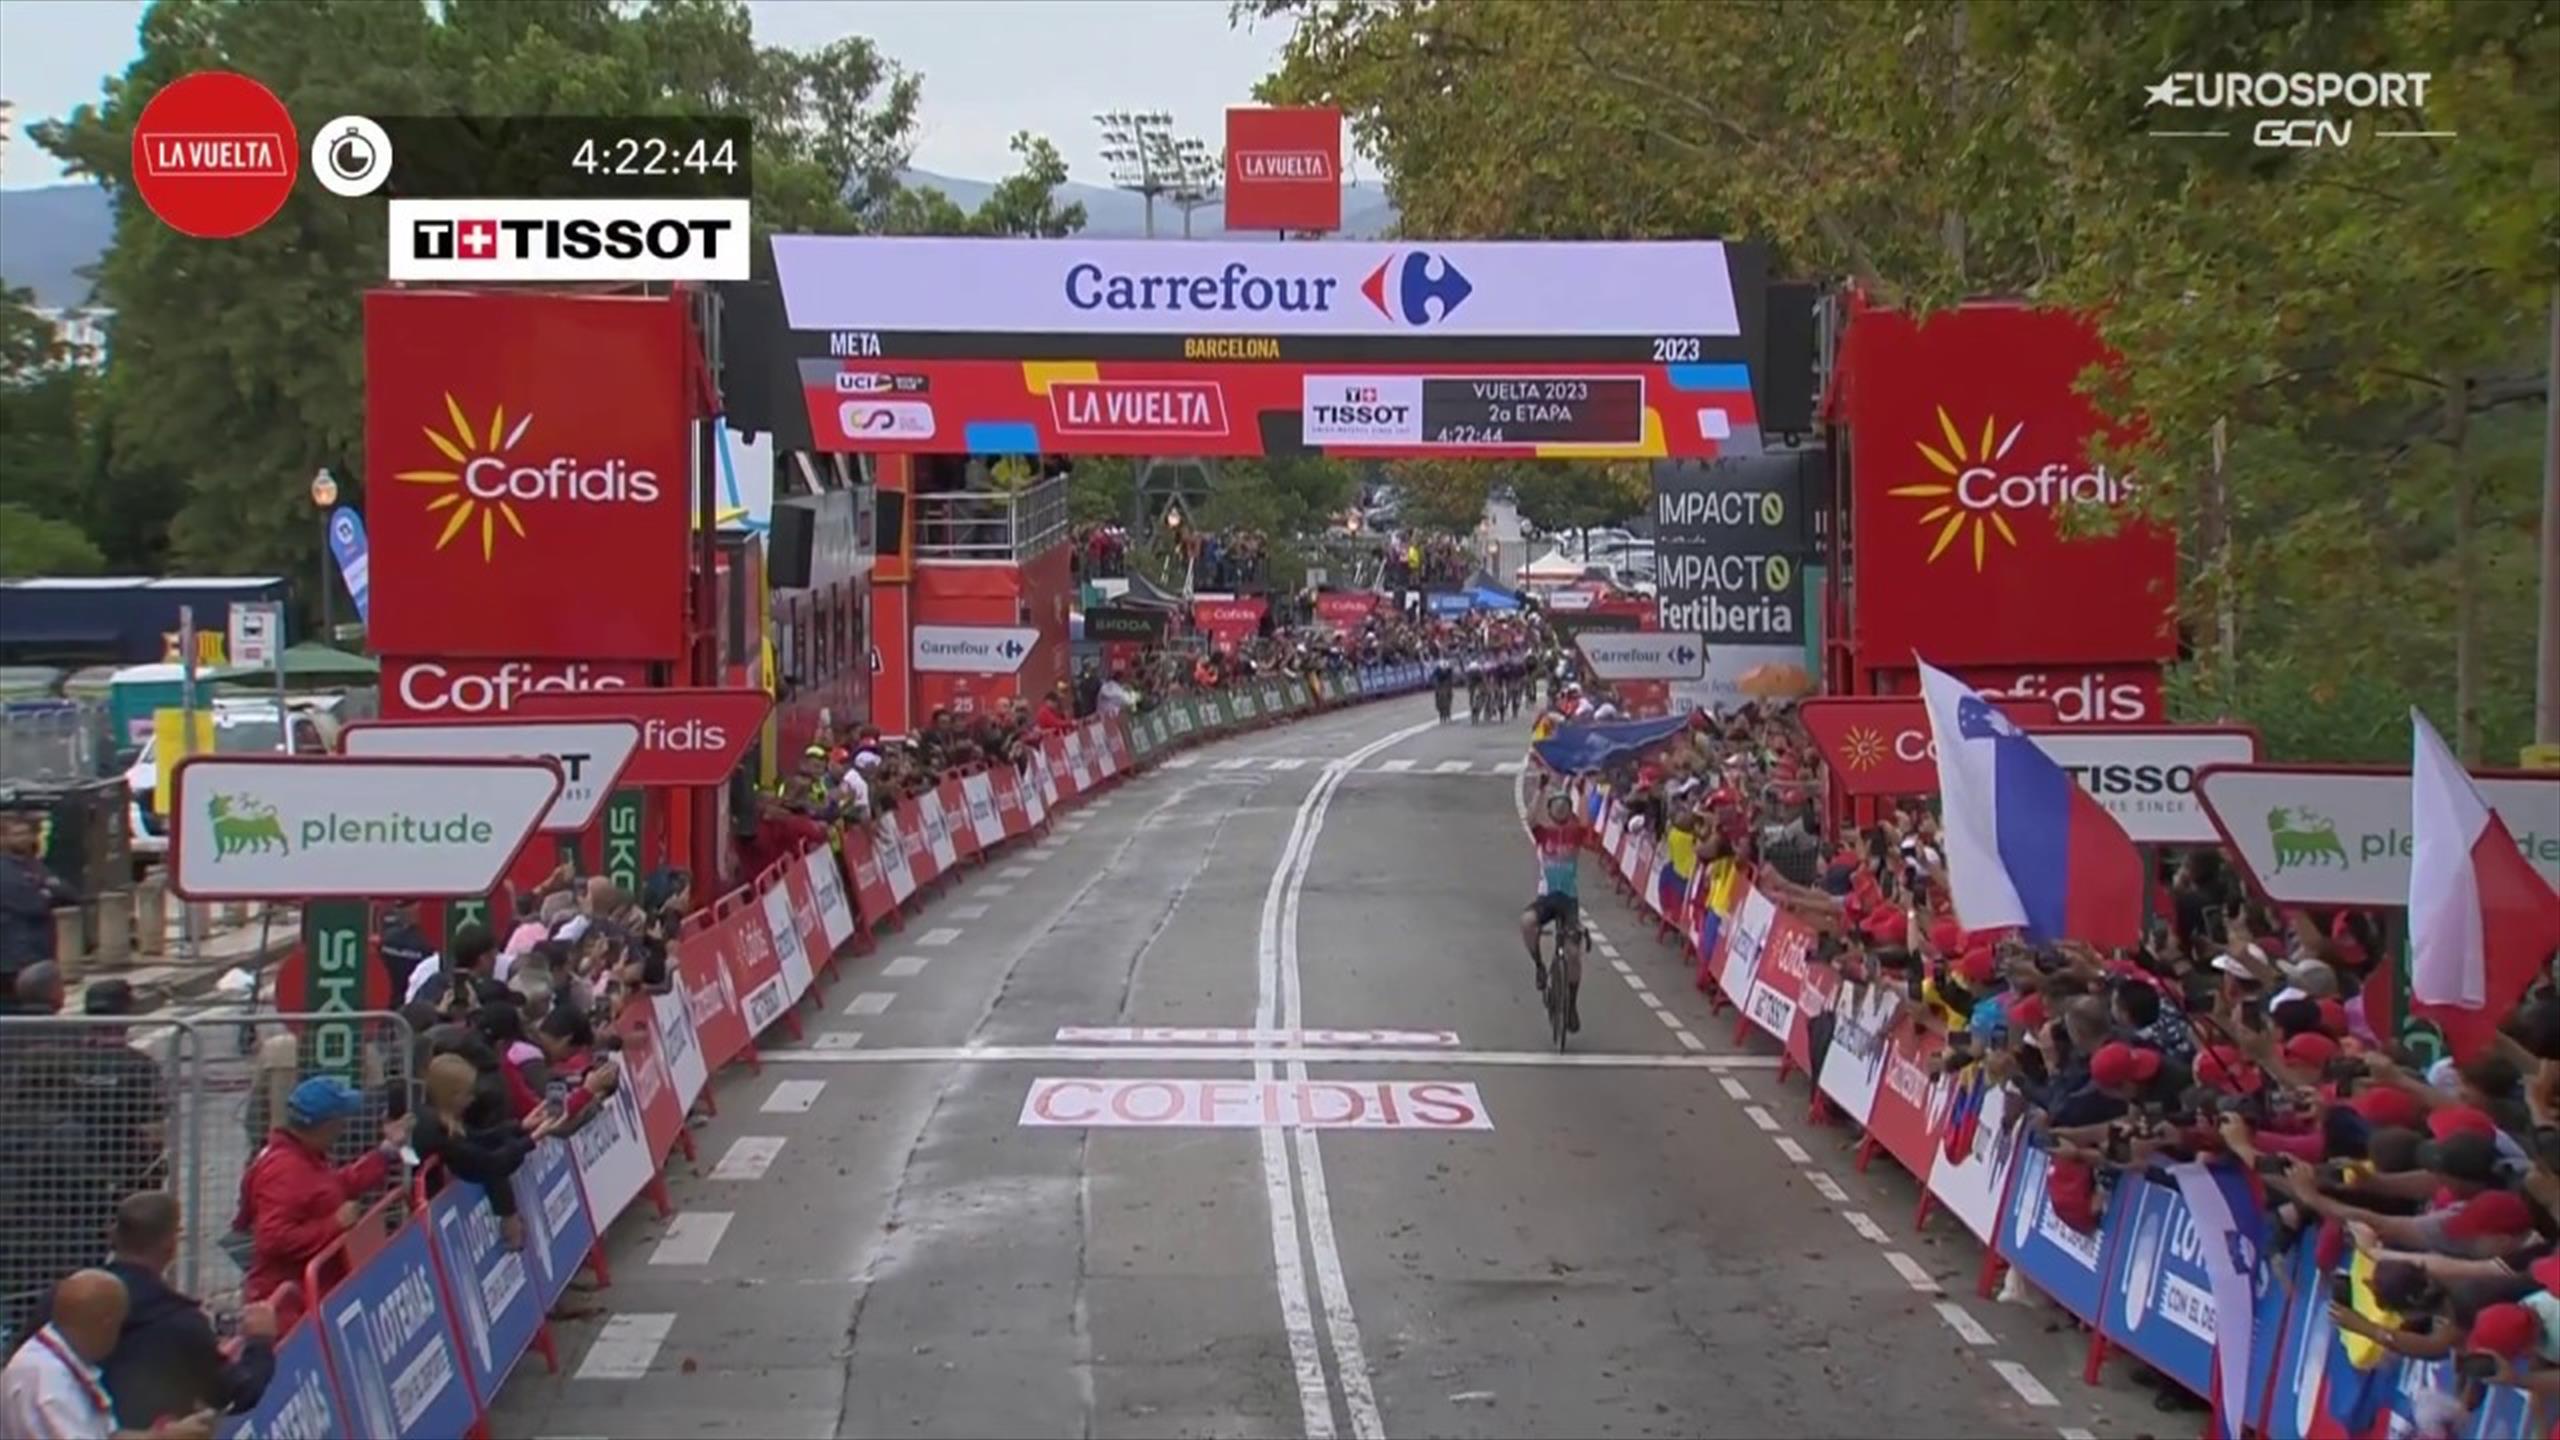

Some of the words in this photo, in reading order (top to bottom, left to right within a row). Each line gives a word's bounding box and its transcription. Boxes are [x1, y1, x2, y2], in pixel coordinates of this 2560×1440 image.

[1246, 156, 1265, 176] LA
[1266, 156, 1322, 176] VUELTA
[1065, 262, 1337, 311] Carrefour
[831, 332, 881, 357] META
[1184, 338, 1280, 359] BARCELONA
[1653, 338, 1700, 362] 2023
[840, 377, 872, 389] UCI
[1472, 382, 1541, 400] VUELTA
[1545, 382, 1588, 400] 2023
[1067, 390, 1101, 424] LA
[1105, 390, 1211, 425] VUELTA
[1313, 405, 1409, 424] TISSOT
[1516, 404, 1573, 422] ETAPA
[1437, 424, 1503, 442] 4:22:44
[465, 456, 660, 503] Cofidis
[1660, 595, 1793, 633] Fertiberia
[920, 640, 990, 656] Carrefour
[1591, 648, 1661, 662] Carrefour
[644, 719, 726, 751] fidis
[302, 812, 493, 850] plenitude
[1033, 1082, 1477, 1126] COFIDIS
